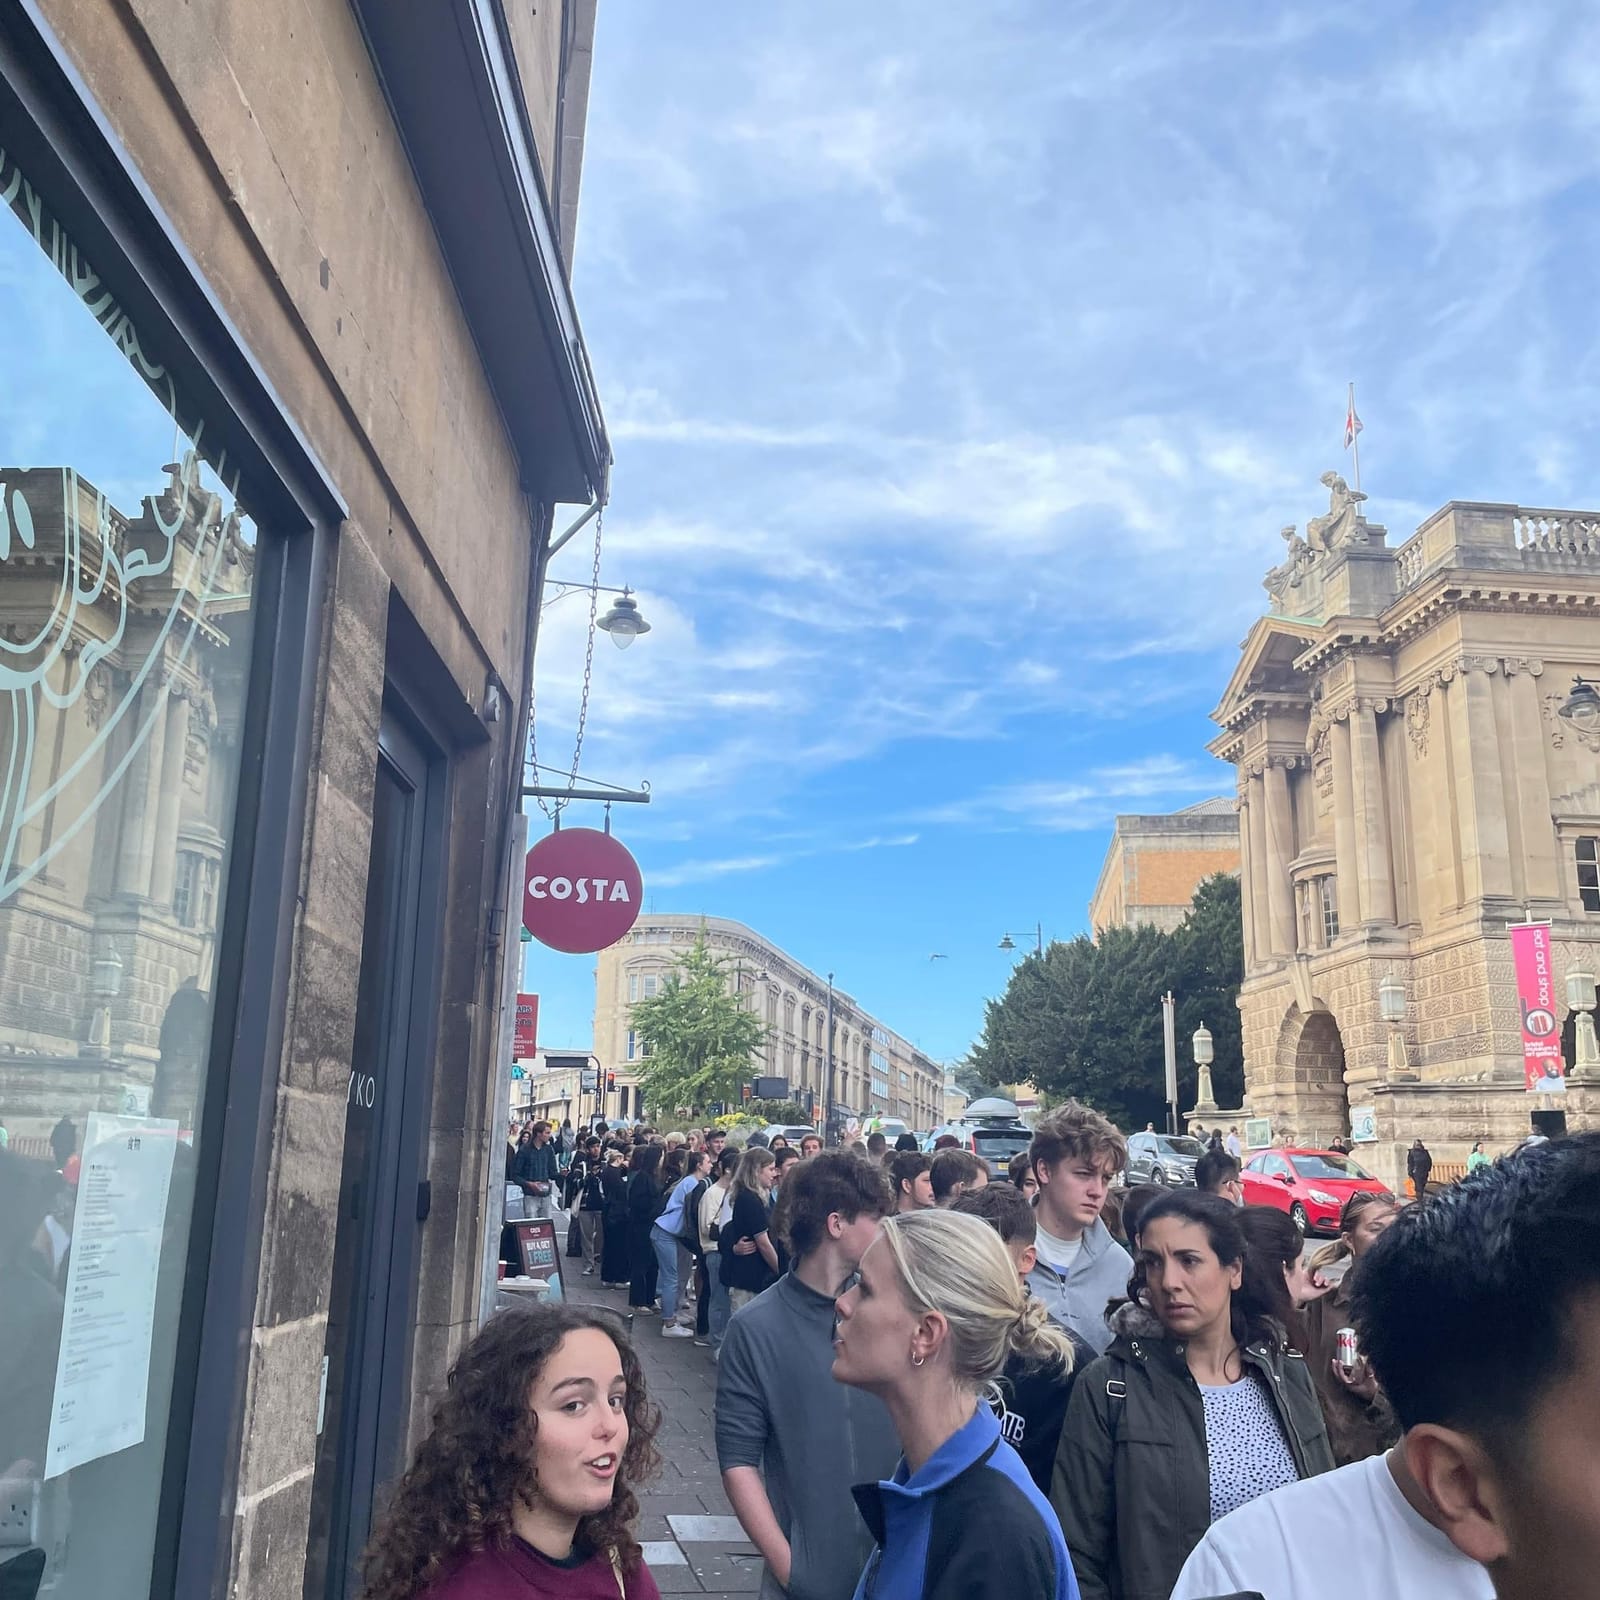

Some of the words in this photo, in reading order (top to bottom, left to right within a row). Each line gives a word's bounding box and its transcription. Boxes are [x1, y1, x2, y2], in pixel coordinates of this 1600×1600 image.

[527, 874, 630, 904] COSTA
[1533, 929, 1546, 948] eat
[1535, 951, 1548, 975] and
[1538, 977, 1550, 1006] shop
